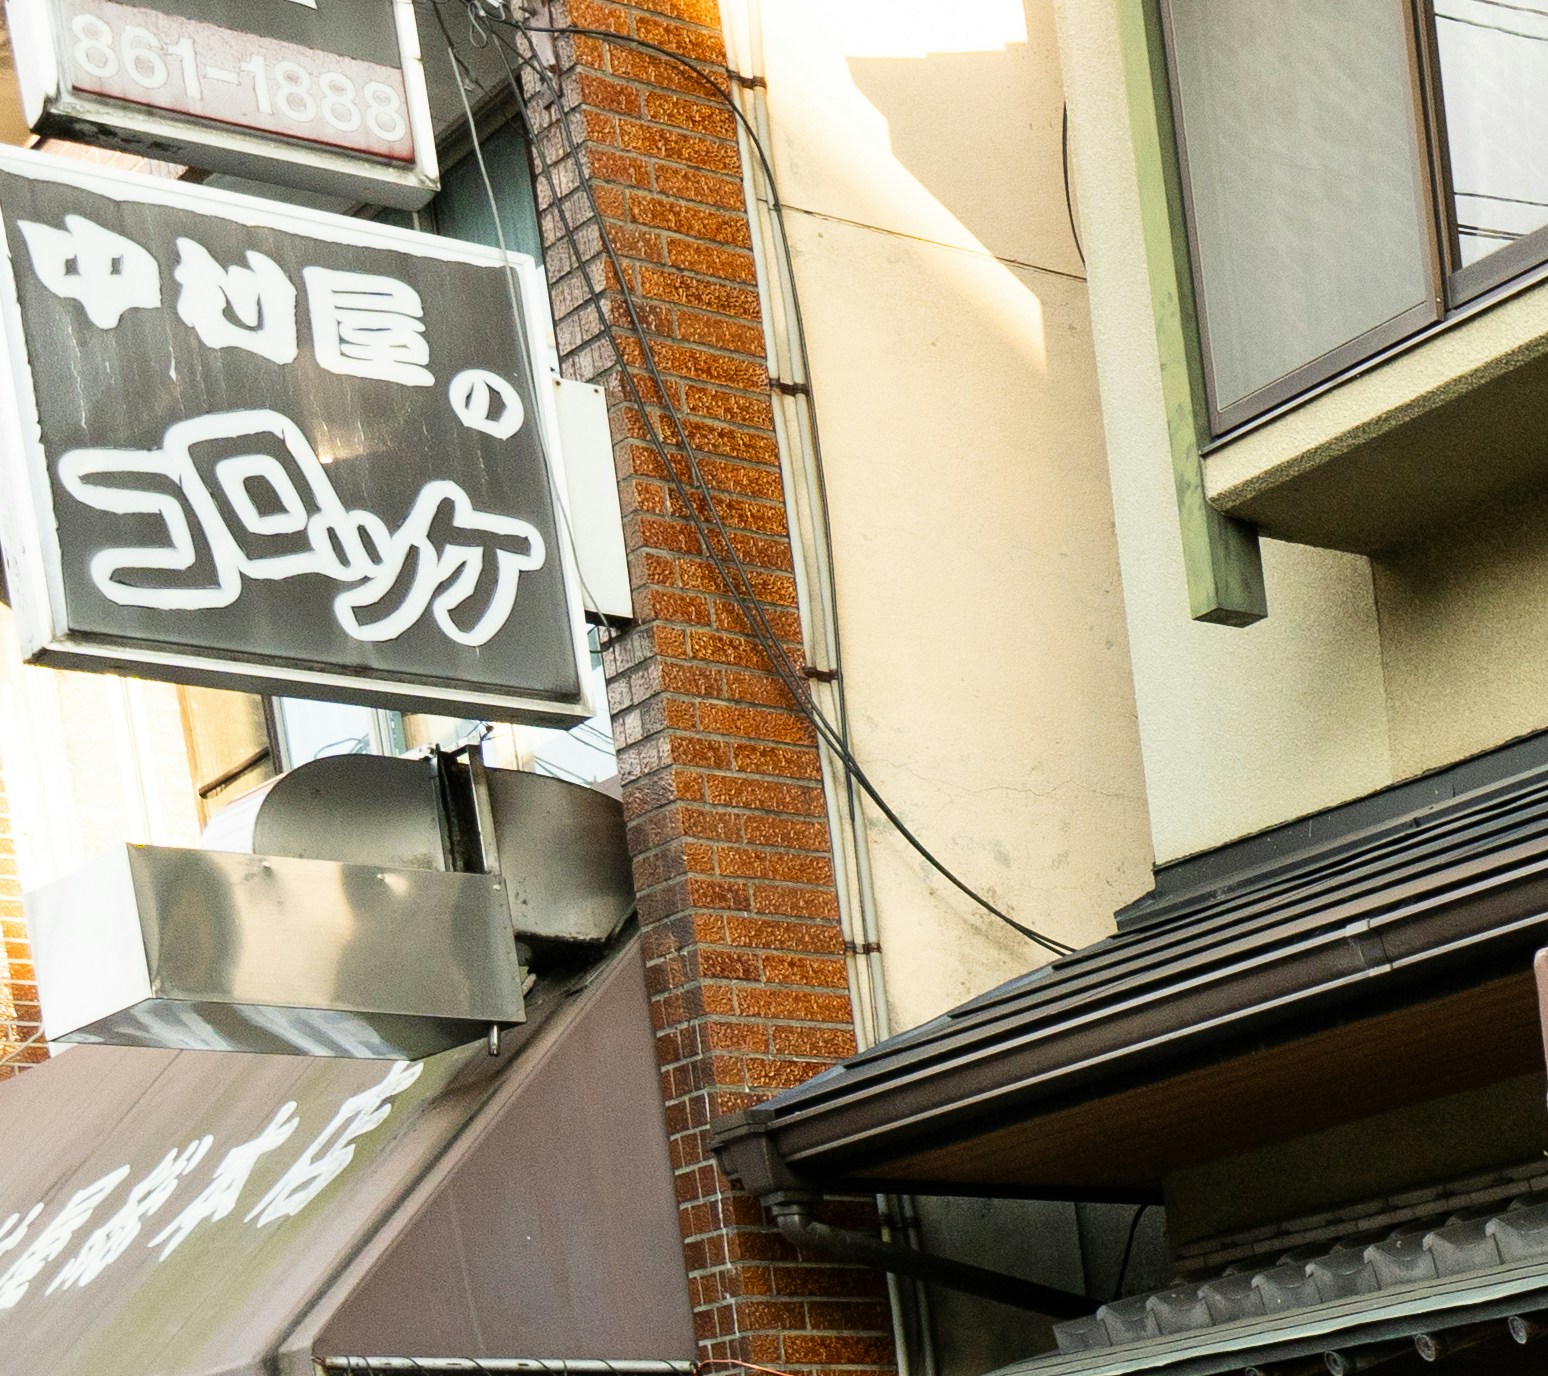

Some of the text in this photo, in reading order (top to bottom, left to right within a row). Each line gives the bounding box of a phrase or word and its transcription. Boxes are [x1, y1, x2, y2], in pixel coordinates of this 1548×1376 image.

[72, 15, 407, 143] 861-1888
[18, 214, 525, 441] 中村屋の
[58, 409, 545, 647] コロッケ
